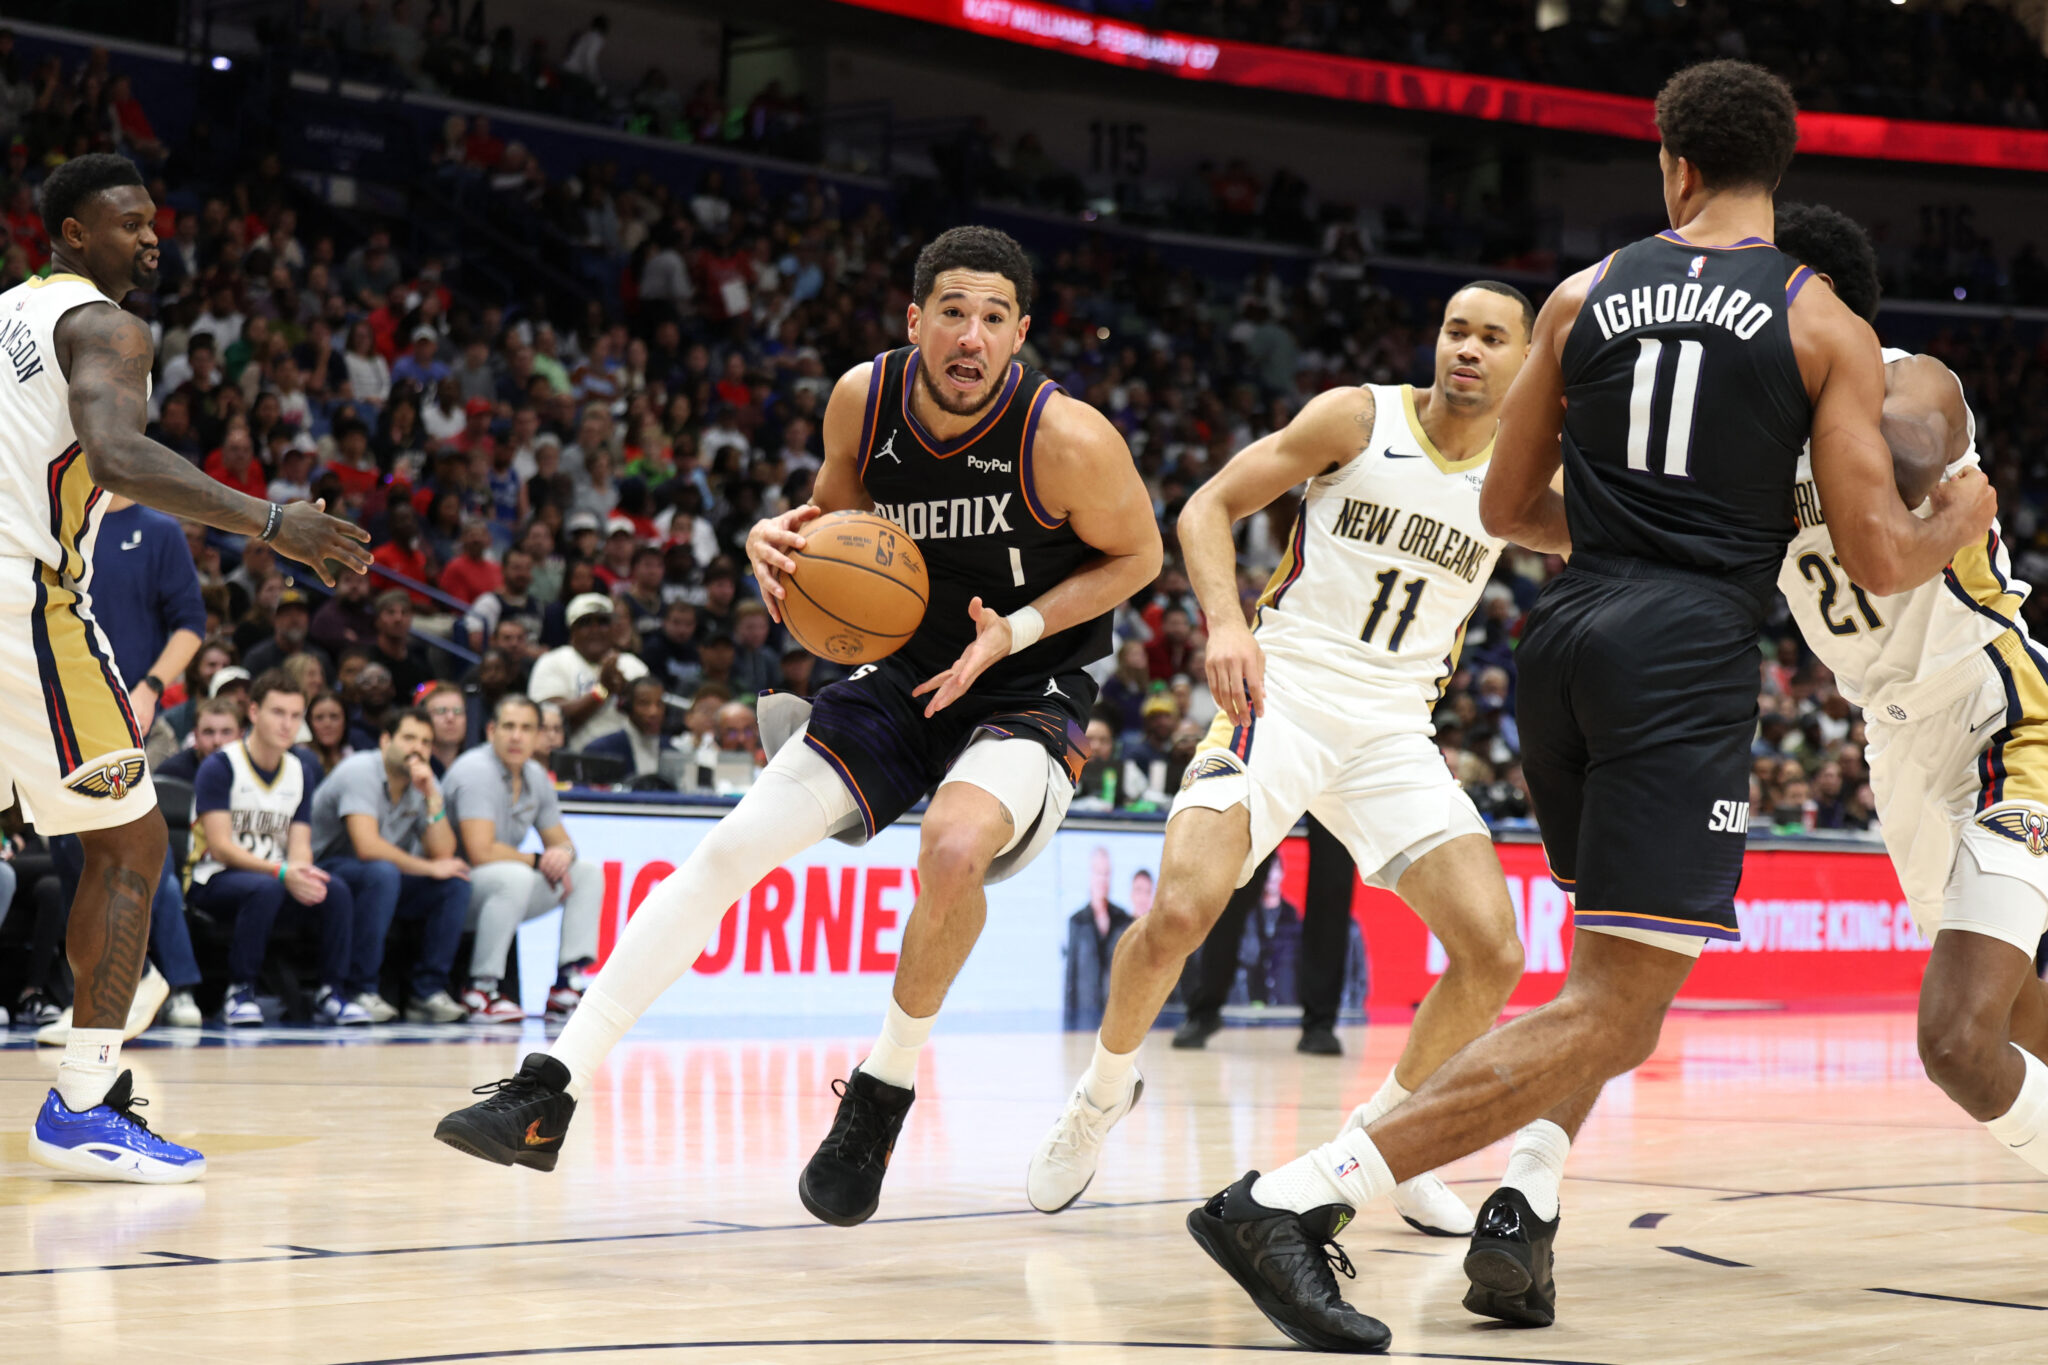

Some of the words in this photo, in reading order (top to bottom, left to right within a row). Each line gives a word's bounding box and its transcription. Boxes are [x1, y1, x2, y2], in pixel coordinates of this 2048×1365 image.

[1187, 43, 1219, 70] 07
[1088, 121, 1148, 175] 115
[1593, 283, 1773, 341] IGHODARO
[1627, 338, 1705, 480] 11
[967, 455, 1012, 473] PayPal
[1008, 547, 1025, 587] 1
[1332, 498, 1401, 546] NEW
[1398, 514, 1490, 583] ORLEANS
[1361, 567, 1428, 653] 11
[584, 861, 921, 974] JRNE
[1704, 900, 1825, 951] OOTHIE
[1826, 900, 1892, 950] KING
